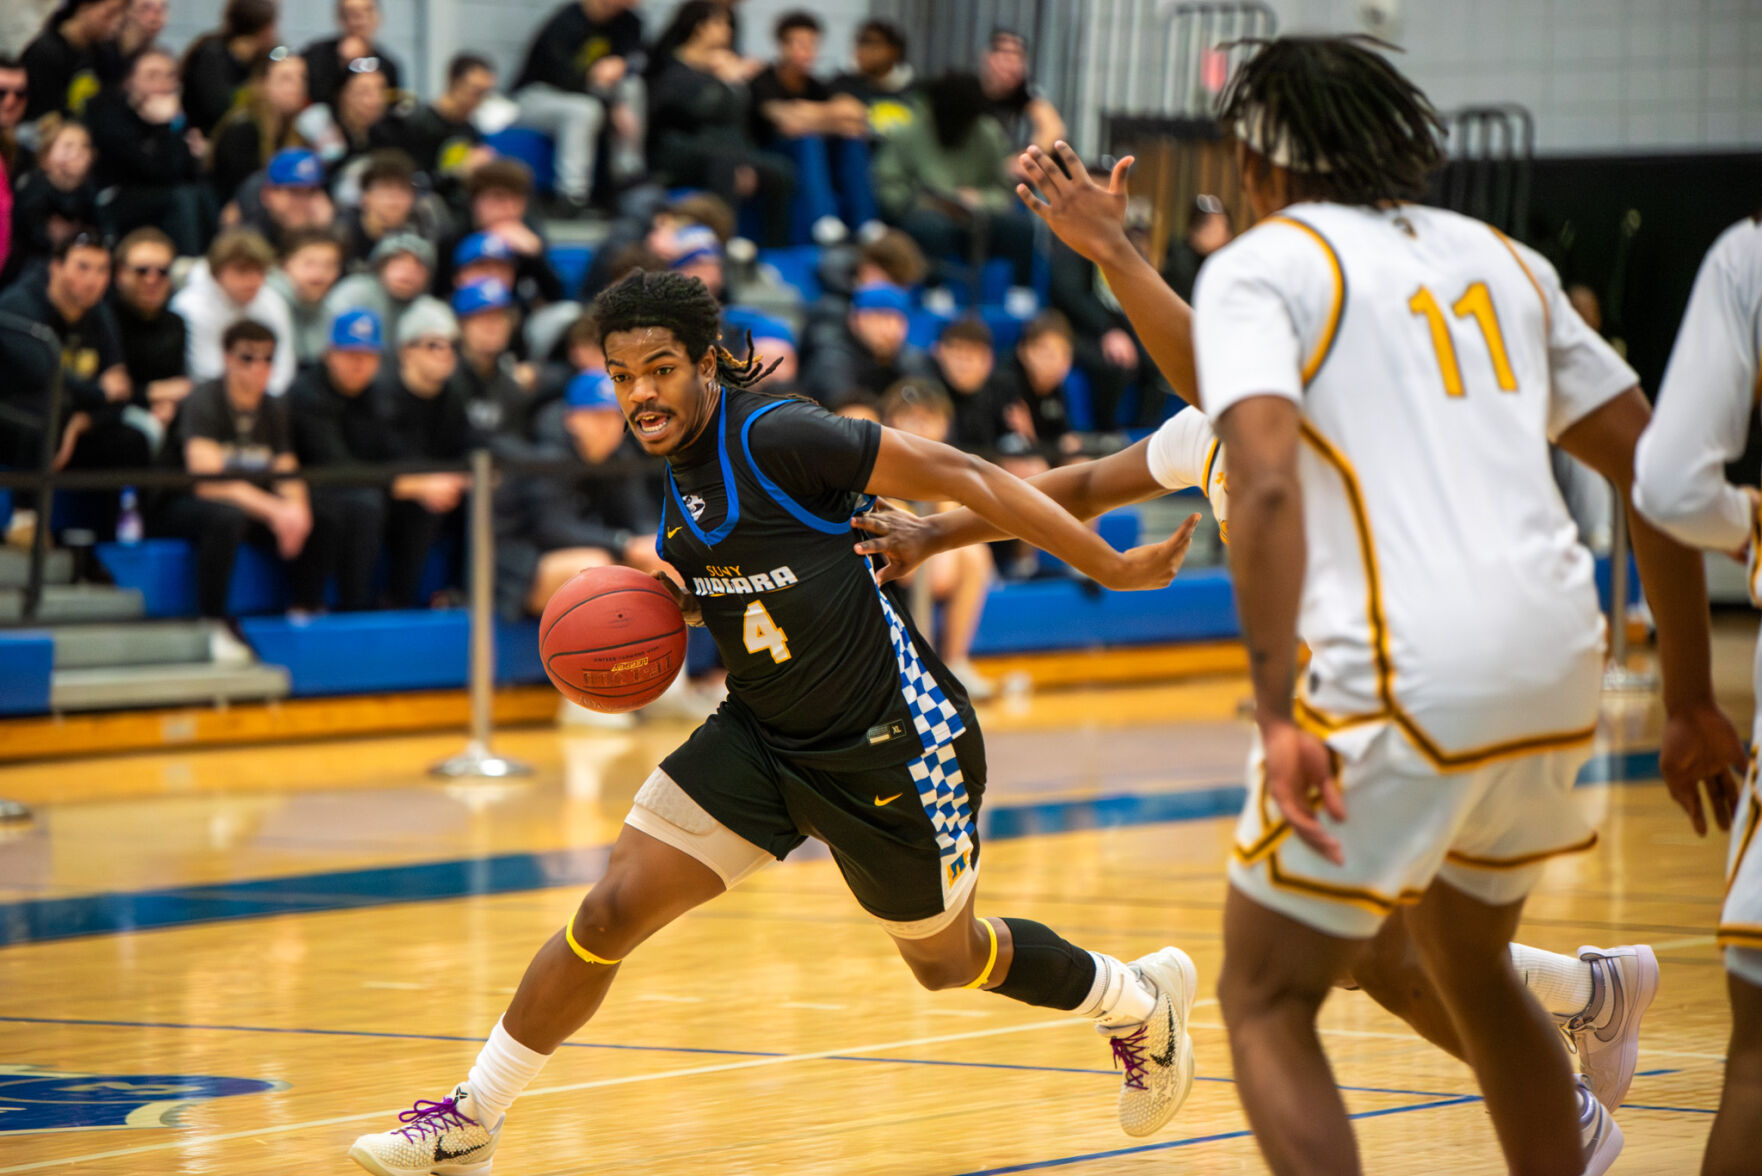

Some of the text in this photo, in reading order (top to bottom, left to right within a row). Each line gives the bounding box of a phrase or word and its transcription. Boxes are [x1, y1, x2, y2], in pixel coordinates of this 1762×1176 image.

[1407, 281, 1518, 397] 11
[706, 565, 742, 577] SUNY
[743, 600, 792, 664] 4
[892, 725, 901, 735] XL
